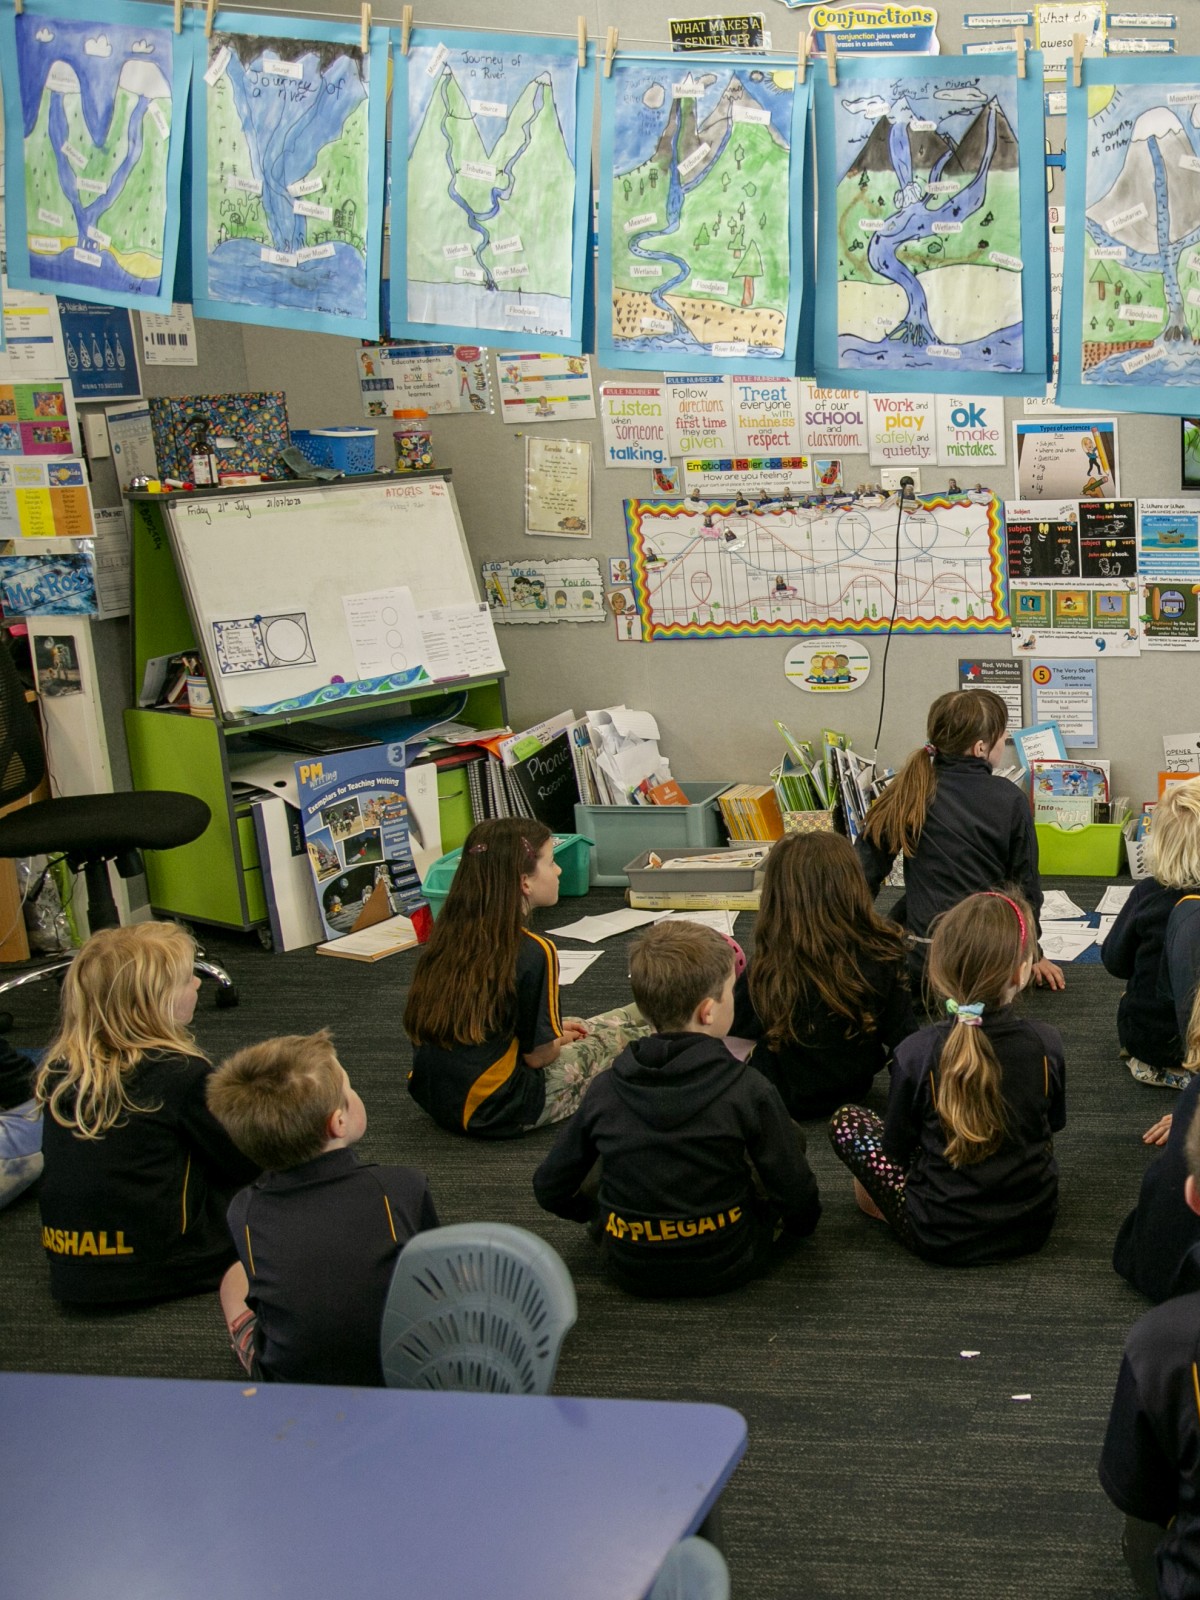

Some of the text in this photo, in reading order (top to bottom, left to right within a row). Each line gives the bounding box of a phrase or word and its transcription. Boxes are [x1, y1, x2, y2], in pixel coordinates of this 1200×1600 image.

[814, 8, 931, 28] Conjunctions
[1039, 11, 1086, 23] What do
[673, 19, 760, 34] WHAT MAKES A
[685, 34, 750, 48] SENTENCE?
[462, 50, 522, 71] Journey of
[251, 72, 345, 101] Journey of
[1169, 92, 1200, 103] Mountains
[928, 181, 959, 193] Tributaries
[1111, 208, 1143, 228] Tributaries
[934, 222, 960, 232] Wetlands
[1093, 248, 1122, 257] Wetlands
[991, 252, 1022, 269] Floodplain
[1125, 308, 1158, 321] Floodplain
[1127, 350, 1166, 371] River Mouth
[672, 388, 708, 399] Follow
[739, 386, 787, 401] Treat
[808, 385, 859, 399] Take care
[609, 400, 662, 416] Listen
[679, 399, 723, 413] directions
[740, 401, 791, 411] everyone
[815, 400, 849, 411] of our
[874, 398, 929, 412] Work and
[949, 398, 963, 407] It's
[772, 409, 792, 417] with
[805, 412, 863, 425] SCHOOL
[951, 403, 987, 428] ok
[676, 417, 727, 429] first time
[739, 415, 795, 428] kindness
[886, 413, 924, 432] play
[616, 425, 663, 441] someone
[683, 428, 700, 436] they
[827, 425, 842, 433] and
[955, 429, 999, 441] make
[747, 431, 791, 450] respect.
[808, 431, 862, 447] classroom.
[876, 431, 929, 447] safely and
[610, 447, 667, 463] talking.
[883, 445, 931, 458] quietly.
[947, 442, 996, 457] mistakes.
[687, 459, 808, 471] Emotional Roller coasters
[741, 473, 758, 481] you
[760, 471, 793, 480] feeling?
[187, 505, 211, 525] Friday
[235, 500, 251, 518] July
[5, 568, 90, 609] Mrs Ross
[1040, 670, 1045, 680] 5
[392, 746, 403, 762] 3
[300, 763, 322, 784] PM
[310, 771, 338, 788] writing
[308, 777, 399, 814] Exemplars for Teaching Writing
[1056, 810, 1089, 822] Wild
[606, 1206, 742, 1241] APPLEGATE
